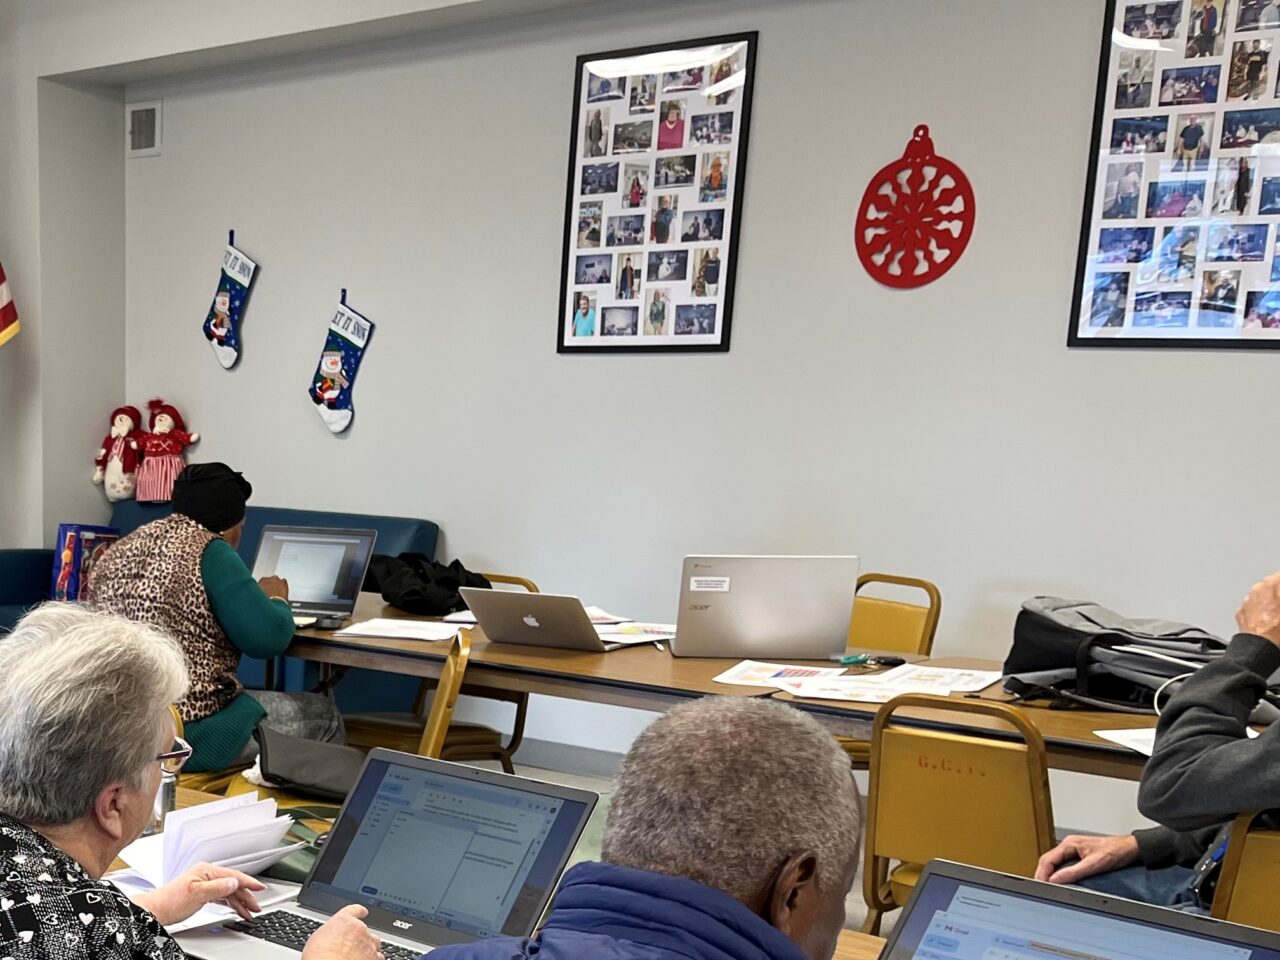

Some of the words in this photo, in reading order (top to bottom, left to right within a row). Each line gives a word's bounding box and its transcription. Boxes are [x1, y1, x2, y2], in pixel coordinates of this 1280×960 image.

[224, 251, 232, 266] ET
[331, 311, 345, 326] ET
[393, 919, 413, 930] acer
